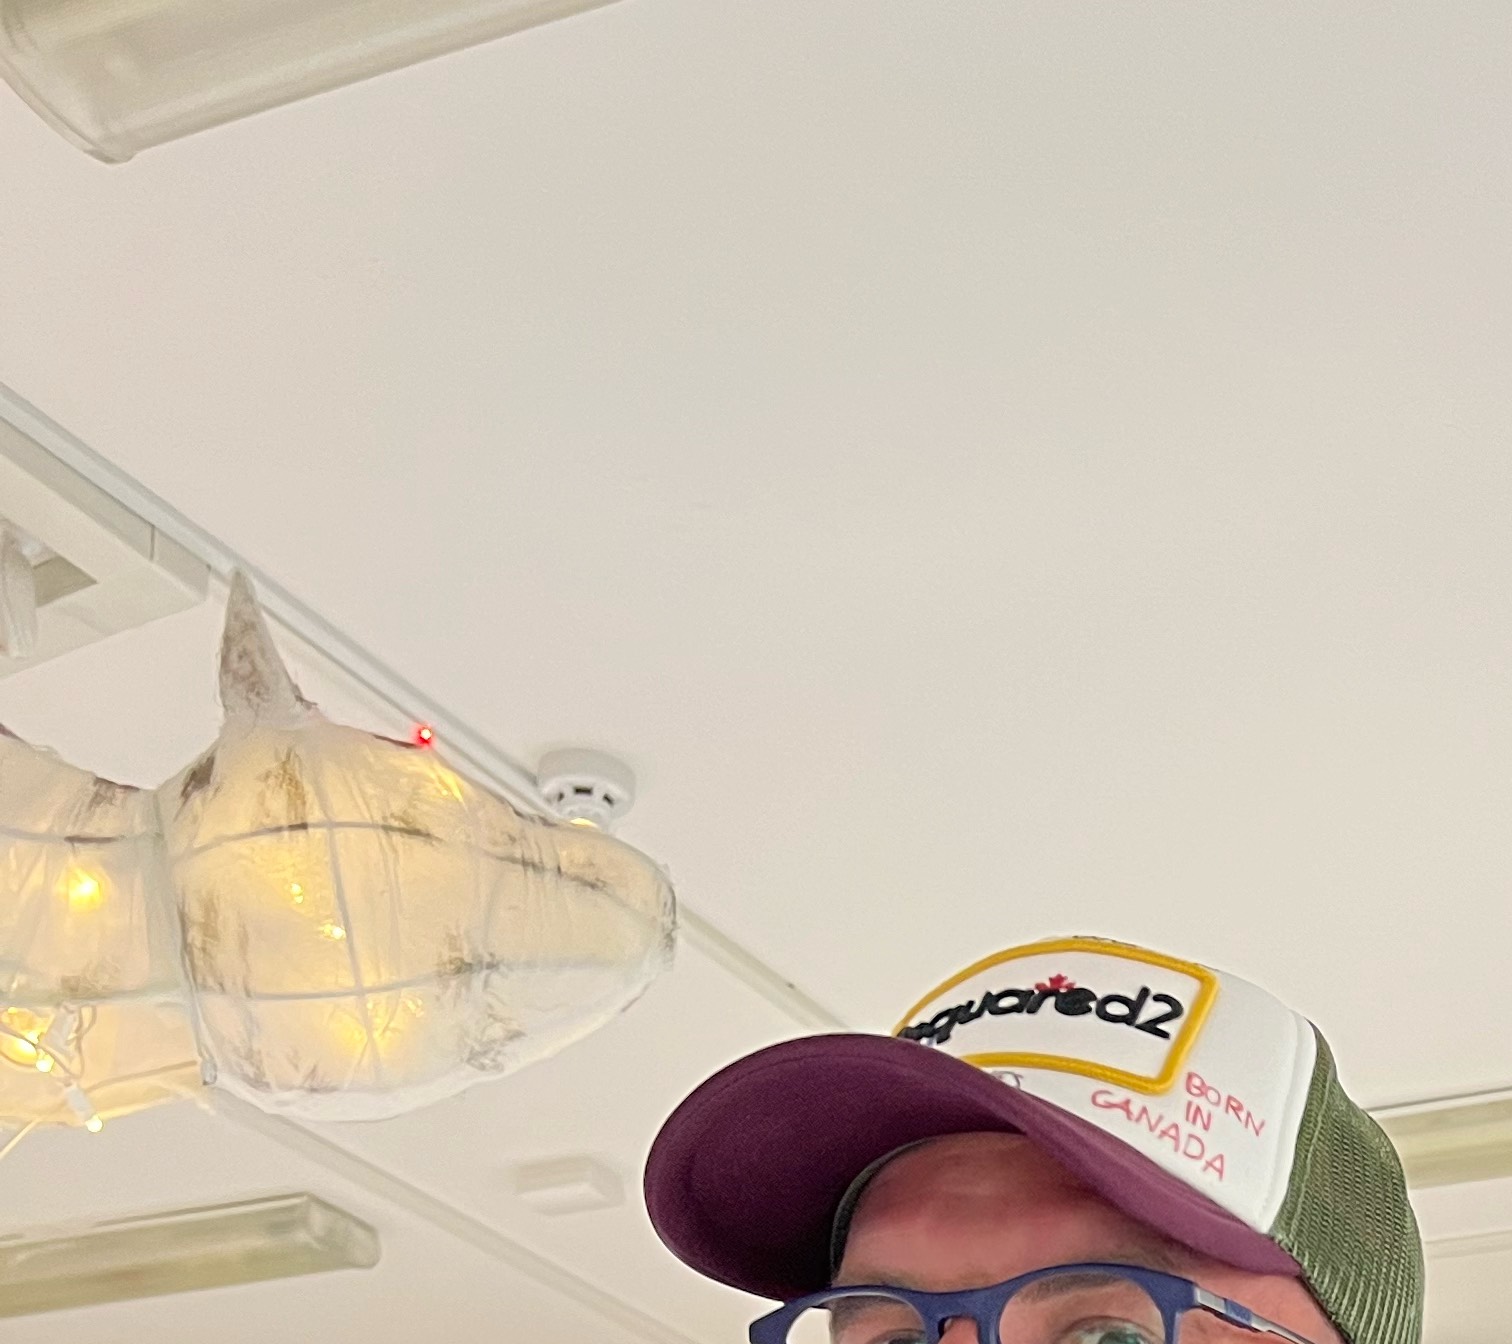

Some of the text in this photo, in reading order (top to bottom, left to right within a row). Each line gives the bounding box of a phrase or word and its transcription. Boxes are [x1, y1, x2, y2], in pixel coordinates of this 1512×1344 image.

[1090, 1089, 1226, 1183] CANADA
[1184, 1070, 1266, 1137] BORN
[1184, 1099, 1213, 1133] IN
